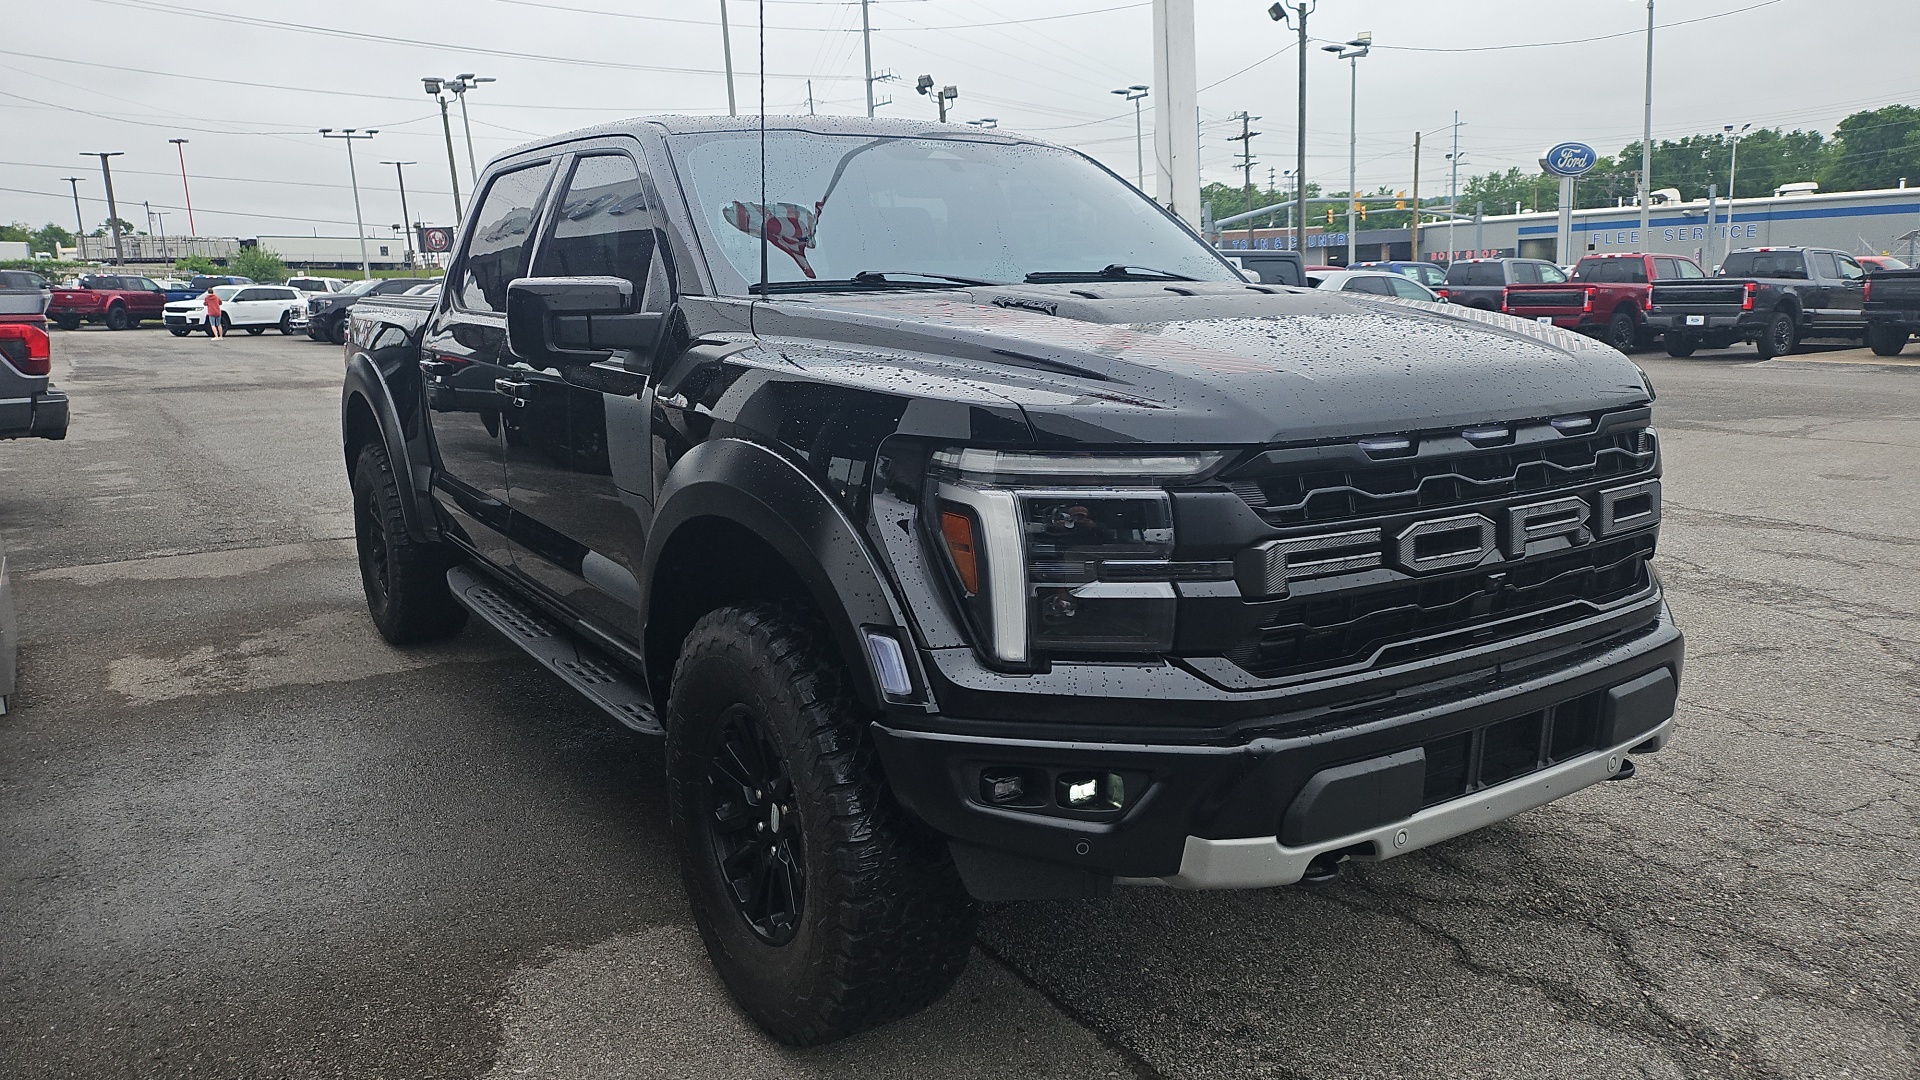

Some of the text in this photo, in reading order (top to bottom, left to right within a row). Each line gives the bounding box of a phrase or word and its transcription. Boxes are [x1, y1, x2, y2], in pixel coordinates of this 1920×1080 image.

[1558, 148, 1588, 168] Ford
[1274, 237, 1282, 249] &
[1288, 233, 1355, 249] CUNTR
[1664, 224, 1757, 242] SERICE
[1263, 477, 1662, 596] FORD
